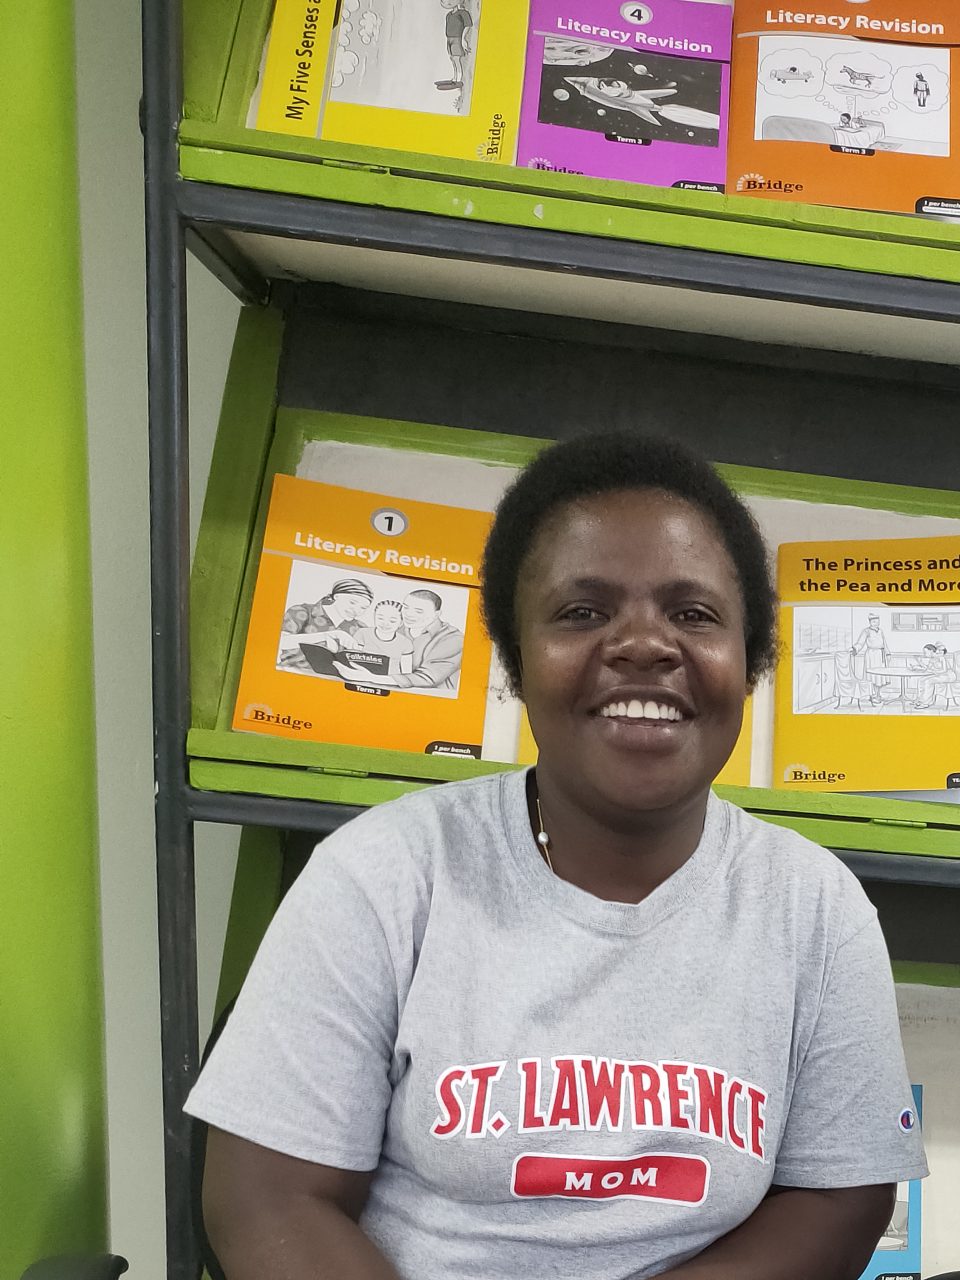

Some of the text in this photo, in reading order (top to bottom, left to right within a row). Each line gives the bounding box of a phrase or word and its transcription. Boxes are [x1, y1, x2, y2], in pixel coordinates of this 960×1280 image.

[628, 8, 644, 21] 4
[766, 10, 945, 36] Literacy Revision
[295, 7, 320, 58] Senses
[556, 17, 713, 54] Literacy Revision
[289, 61, 312, 93] Five
[285, 95, 311, 121] My
[486, 113, 506, 156] Bridge
[616, 135, 637, 144] Term
[840, 146, 860, 155] Term
[745, 179, 804, 194] Bridge
[384, 516, 395, 532] 1
[294, 532, 475, 576] Literacy Revision
[802, 557, 838, 572] The
[843, 557, 923, 572] Princess
[799, 578, 831, 592] the
[836, 578, 871, 592] Pea
[876, 578, 913, 592] and
[252, 709, 313, 731] Bridge
[792, 770, 846, 783] Bridge
[429, 1055, 769, 1165] ST. LAWRENCE
[564, 1167, 658, 1192] MOM
